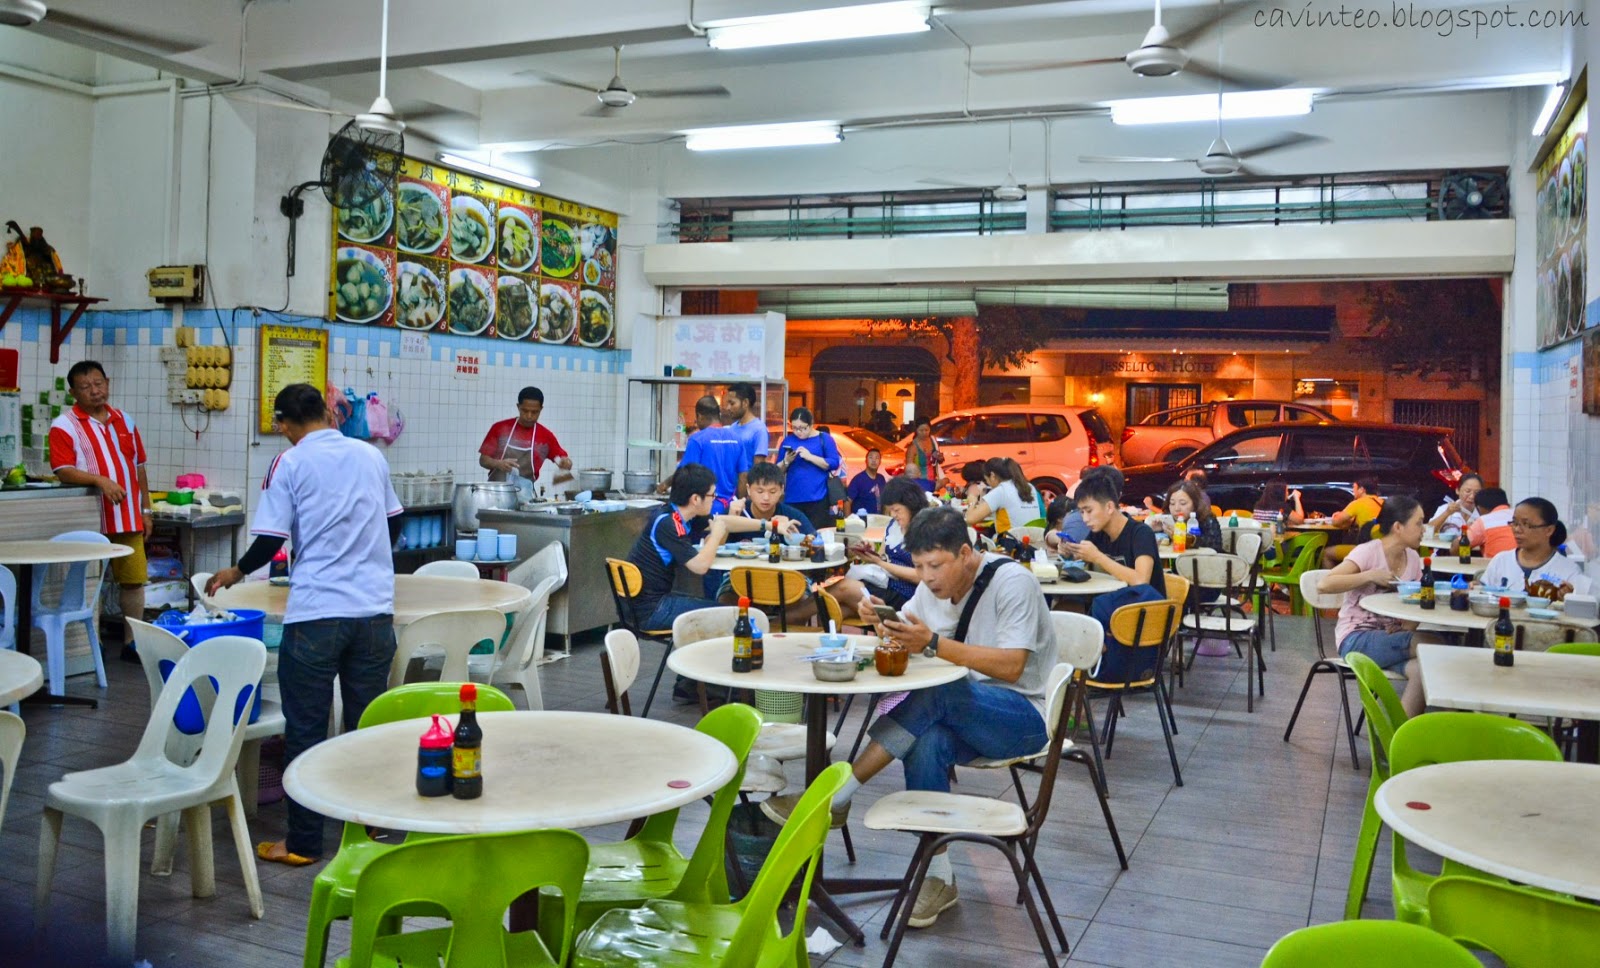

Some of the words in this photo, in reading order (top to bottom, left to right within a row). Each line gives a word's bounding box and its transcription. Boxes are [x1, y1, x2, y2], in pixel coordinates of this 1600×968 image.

[532, 330, 539, 338] 10
[457, 356, 479, 364] 下午四点
[1172, 359, 1217, 372] HOTEL
[457, 366, 478, 374] 开始营业
